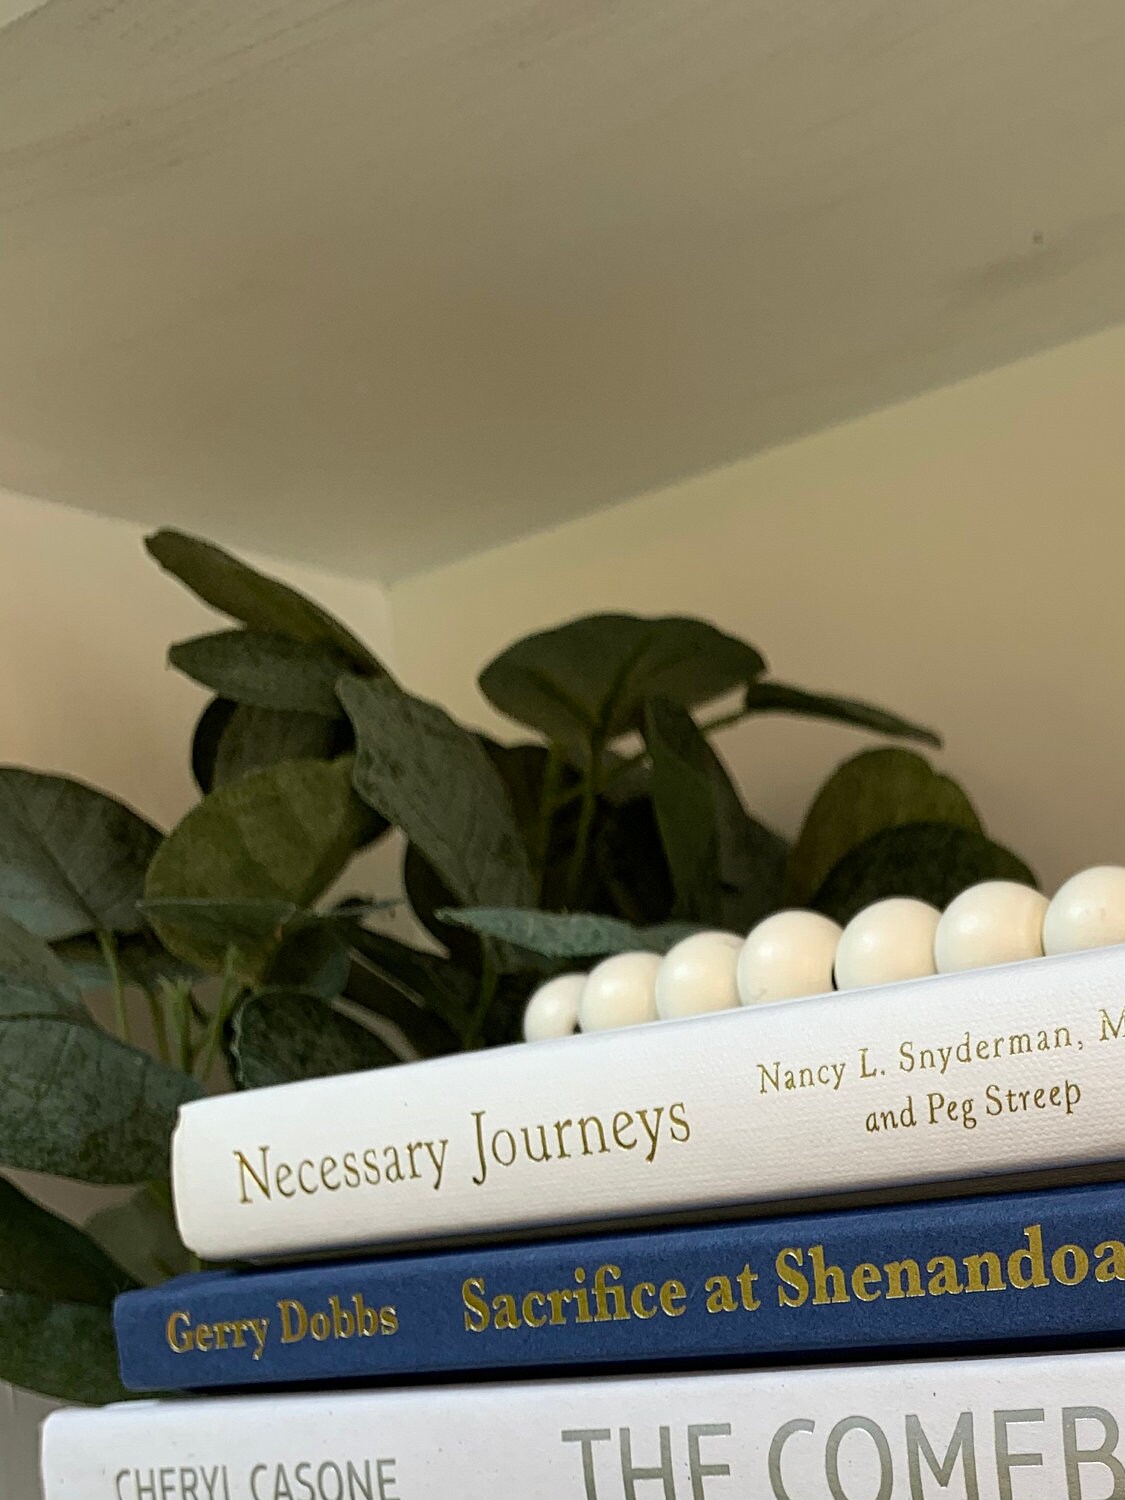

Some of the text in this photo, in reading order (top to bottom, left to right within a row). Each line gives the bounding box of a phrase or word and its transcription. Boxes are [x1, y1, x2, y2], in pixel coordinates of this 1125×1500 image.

[757, 1051, 846, 1094] Nancy
[859, 1048, 886, 1079] L.
[899, 1024, 1084, 1076] Snyderman,
[865, 1069, 1083, 1133] and Peg Streep
[234, 1100, 692, 1205] Necessary Journeys
[164, 1295, 400, 1362] Gerry Dobbs
[461, 1263, 688, 1335] Sacrifice
[704, 1263, 760, 1312] at
